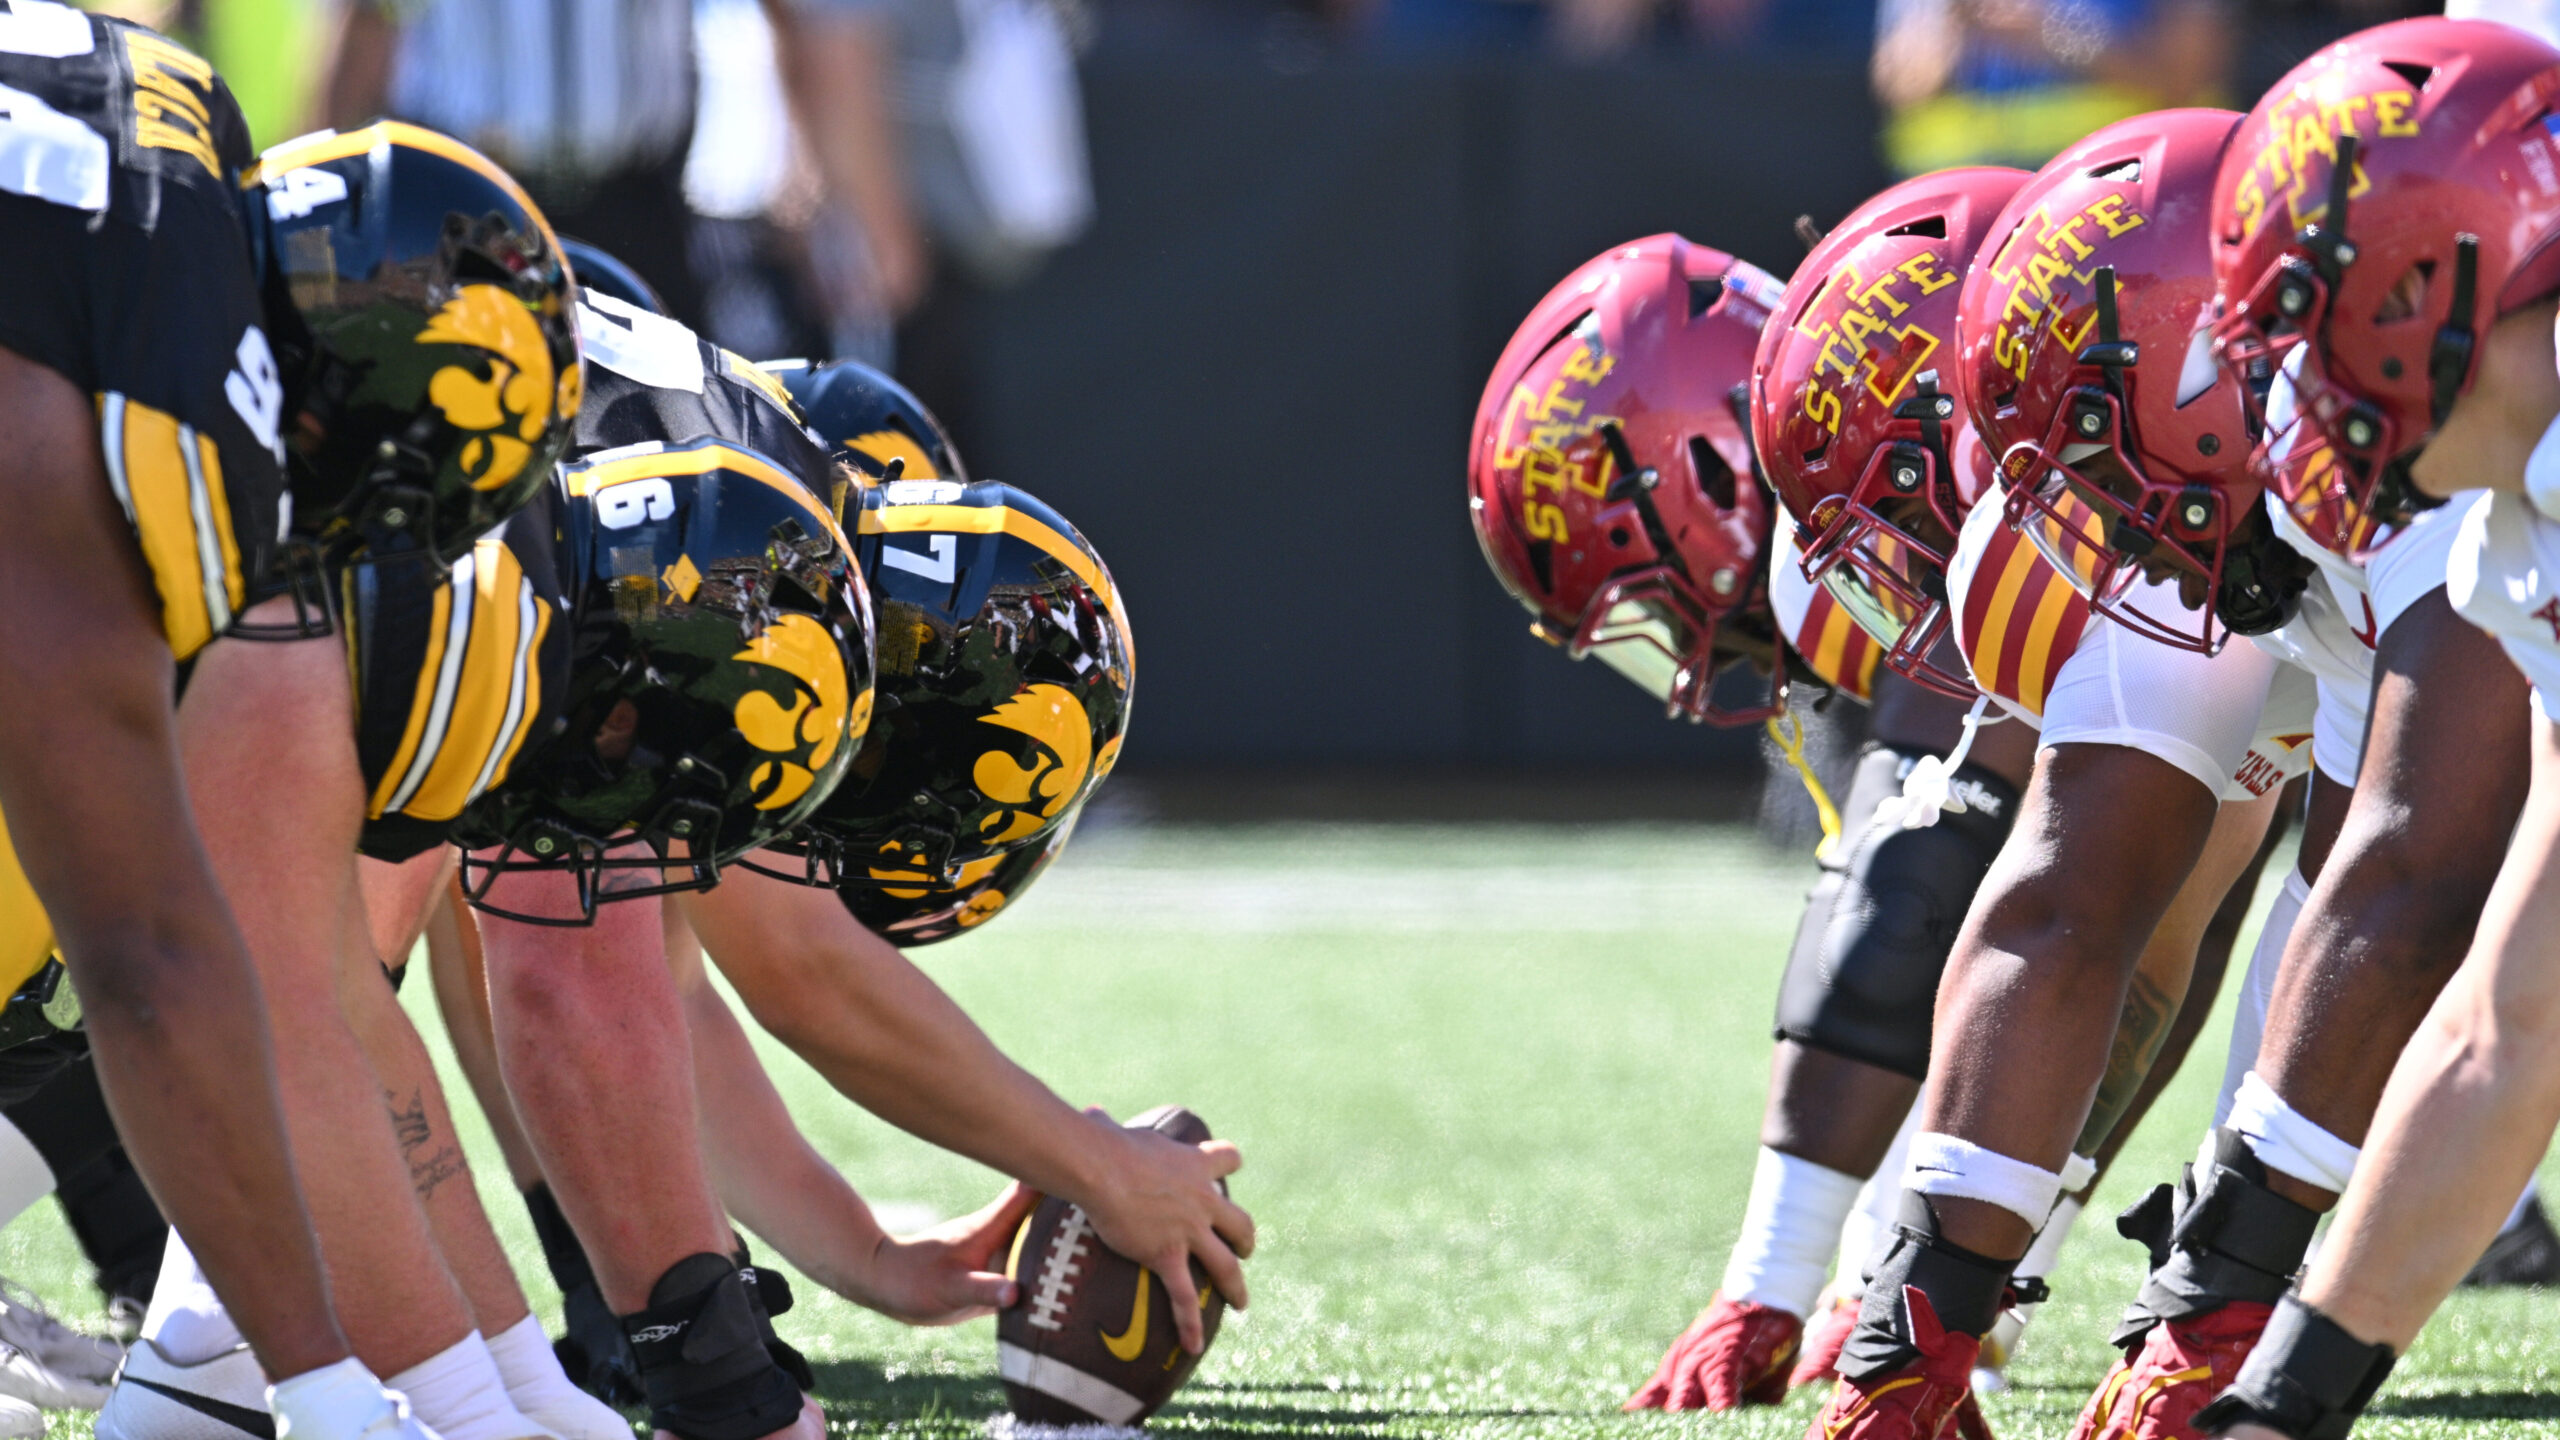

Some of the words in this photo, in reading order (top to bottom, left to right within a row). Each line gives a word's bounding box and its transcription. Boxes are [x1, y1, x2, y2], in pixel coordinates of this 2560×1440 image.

[2234, 90, 2420, 237] STATE
[1805, 252, 1958, 435] STATE
[1994, 193, 2145, 382] STATE
[595, 477, 676, 530] 6
[1523, 346, 1616, 545] STATE
[882, 534, 957, 584] 7
